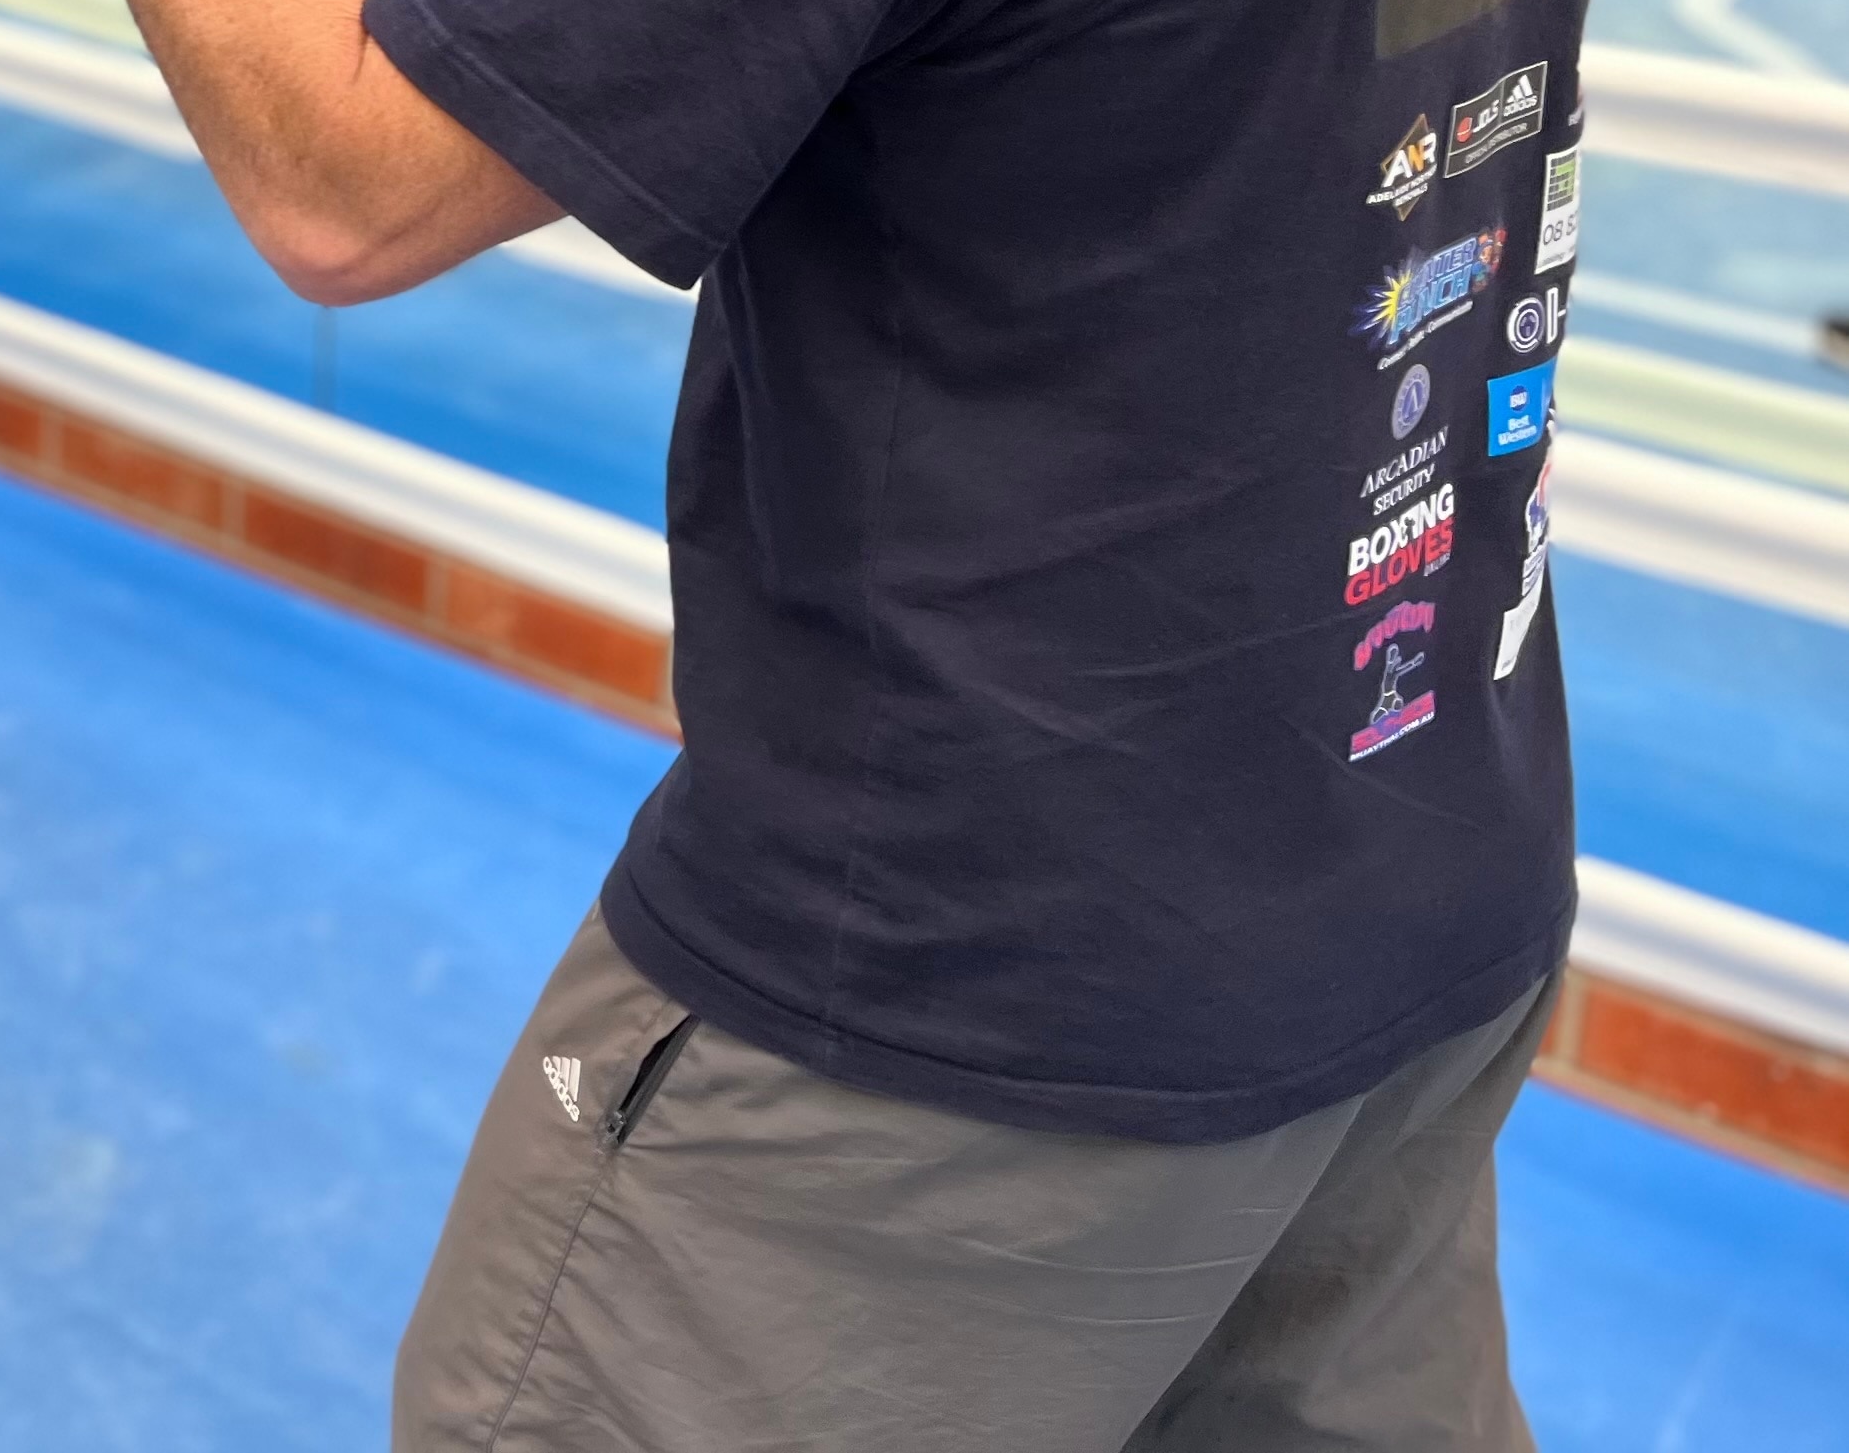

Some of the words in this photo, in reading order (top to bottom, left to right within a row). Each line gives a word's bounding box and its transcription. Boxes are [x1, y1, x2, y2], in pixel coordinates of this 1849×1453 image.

[1381, 132, 1437, 188] ANR
[1543, 220, 1564, 246] 08
[1387, 263, 1473, 345] PUNCH
[1360, 425, 1449, 498] ARCADIAN
[1373, 463, 1436, 516] SECURITY
[1344, 515, 1454, 605] GLOVES
[1348, 483, 1455, 576] BOXING
